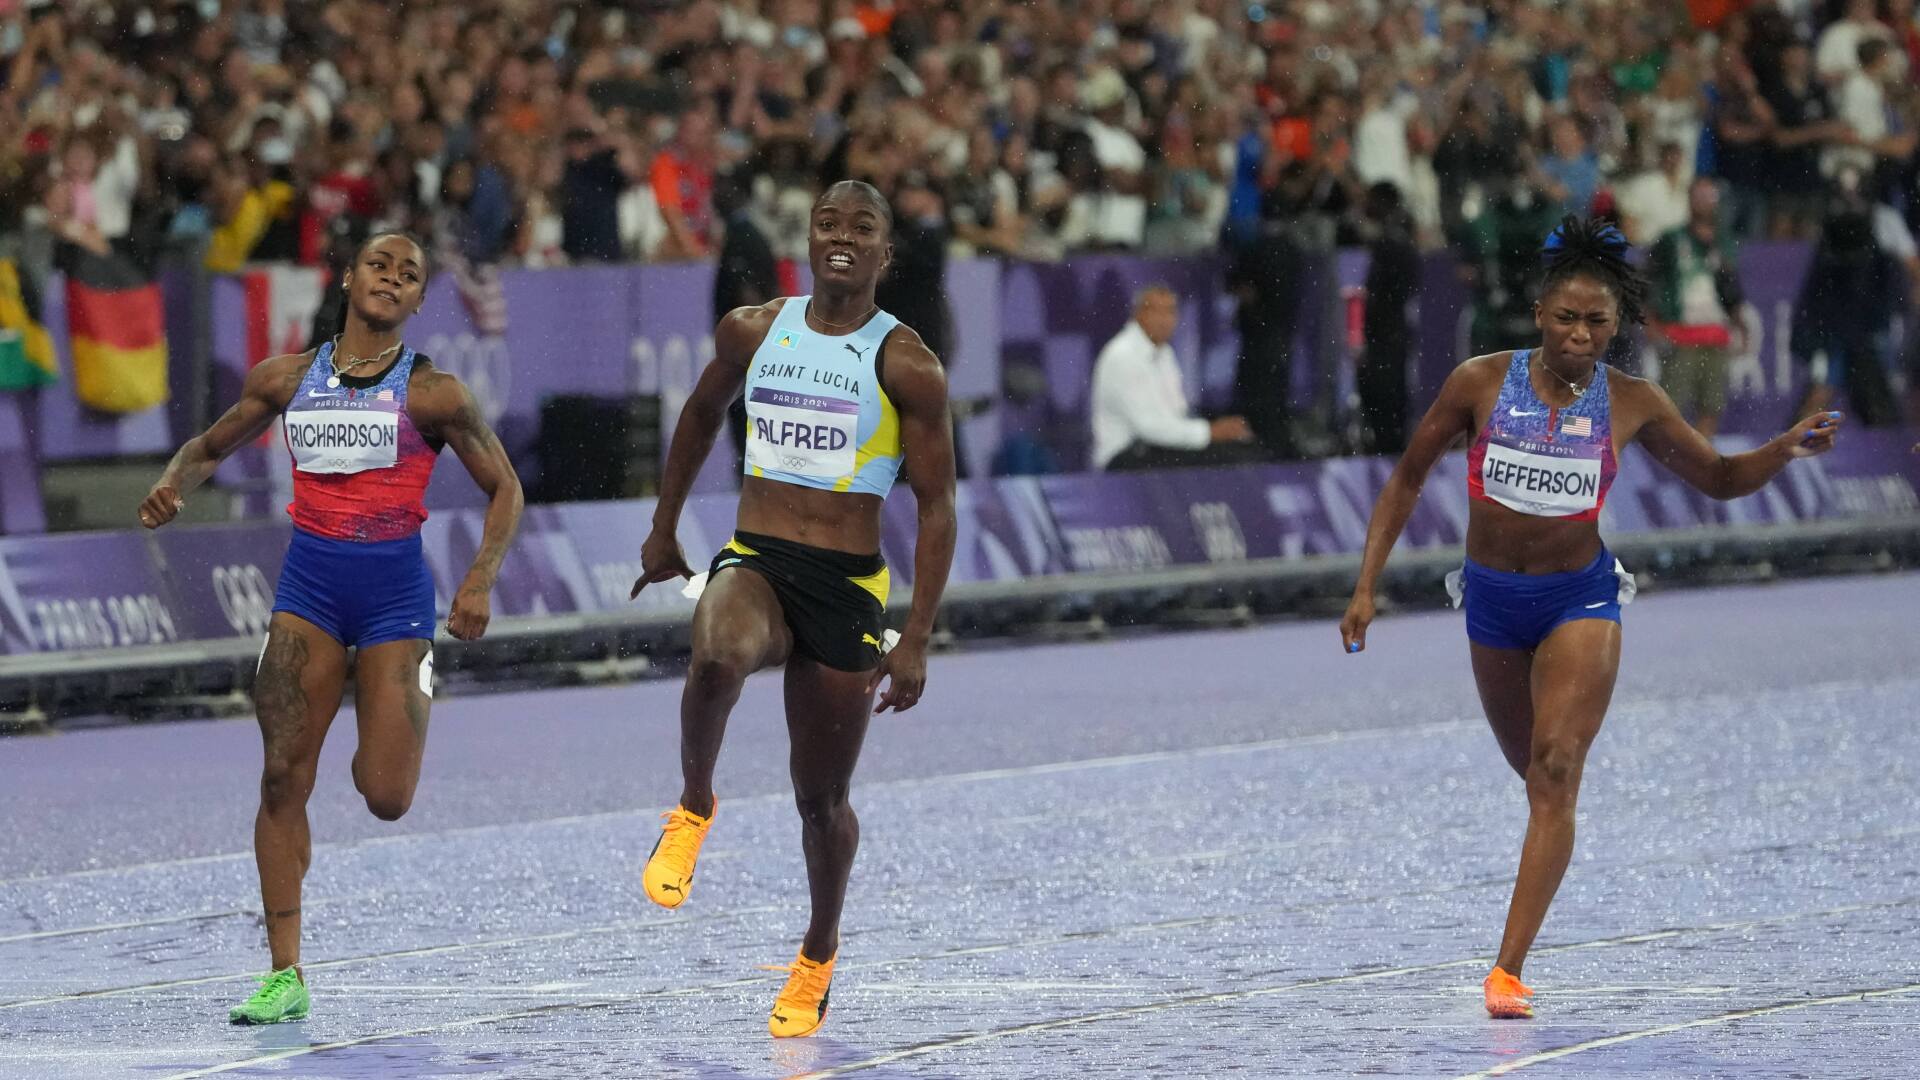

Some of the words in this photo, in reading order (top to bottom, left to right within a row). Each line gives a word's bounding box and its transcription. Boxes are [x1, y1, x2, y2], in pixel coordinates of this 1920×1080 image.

[758, 363, 806, 380] SAINT
[814, 369, 860, 396] LUCIA
[315, 400, 341, 408] PARIS
[343, 400, 370, 408] 2024
[773, 393, 800, 405] PARIS
[802, 398, 828, 408] 2024
[290, 423, 394, 447] RICHARDSON
[756, 417, 848, 451] ALFRED
[1519, 441, 1546, 452] PARIS
[1549, 445, 1575, 455] 2024
[1486, 458, 1596, 496] JEFFERSON
